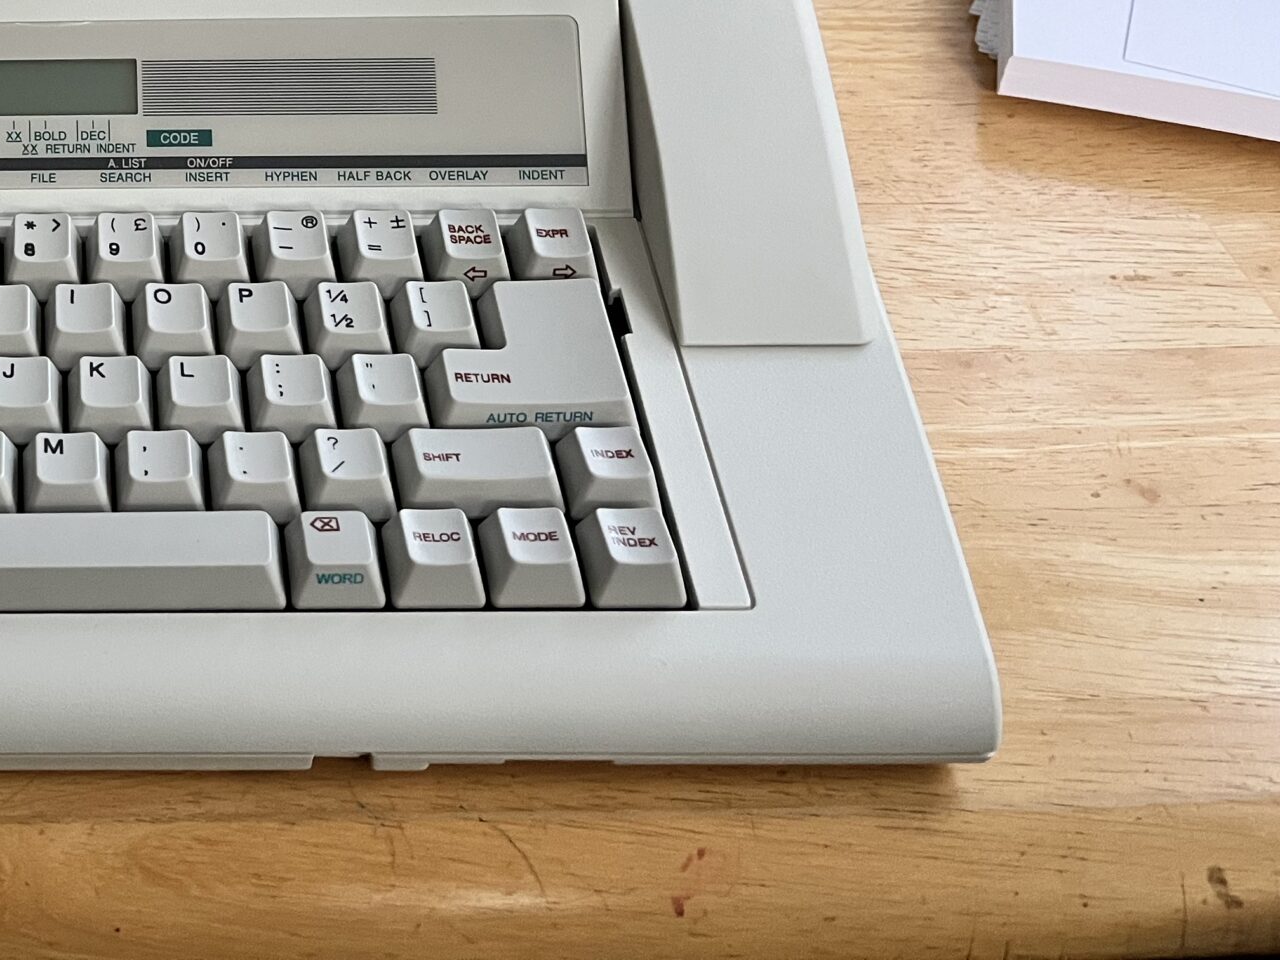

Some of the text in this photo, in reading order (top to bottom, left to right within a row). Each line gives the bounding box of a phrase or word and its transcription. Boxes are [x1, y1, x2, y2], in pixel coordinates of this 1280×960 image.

[35, 131, 66, 141] BOLD
[81, 131, 105, 140] DEC
[161, 133, 198, 143] CODE
[46, 144, 90, 153] RETURN
[97, 143, 136, 153] INDENT
[123, 159, 146, 168] LIST
[187, 158, 232, 167] ON/OFF
[31, 173, 56, 183] FILE
[100, 172, 151, 182] SEARCH
[186, 172, 230, 182] INSERT
[265, 171, 317, 181] HYPHEN
[338, 171, 411, 181] HALF BACK
[429, 171, 488, 180] OVERLAY
[519, 170, 565, 180] INDENT
[448, 225, 484, 234] BACK
[537, 229, 568, 237] EXPR
[450, 234, 491, 244] SPACE
[239, 288, 253, 303] P
[3, 363, 14, 378] J
[90, 362, 105, 378] K
[180, 362, 194, 377] L
[455, 373, 511, 383] RETURN
[487, 411, 593, 423] AUTO RETURN
[44, 438, 63, 454] M
[423, 453, 460, 462] SHIFT
[591, 448, 634, 459] INDEX
[413, 531, 461, 542] RELOC
[513, 531, 558, 542] MODE
[612, 536, 657, 548] INDEX
[316, 573, 364, 584] WORD
